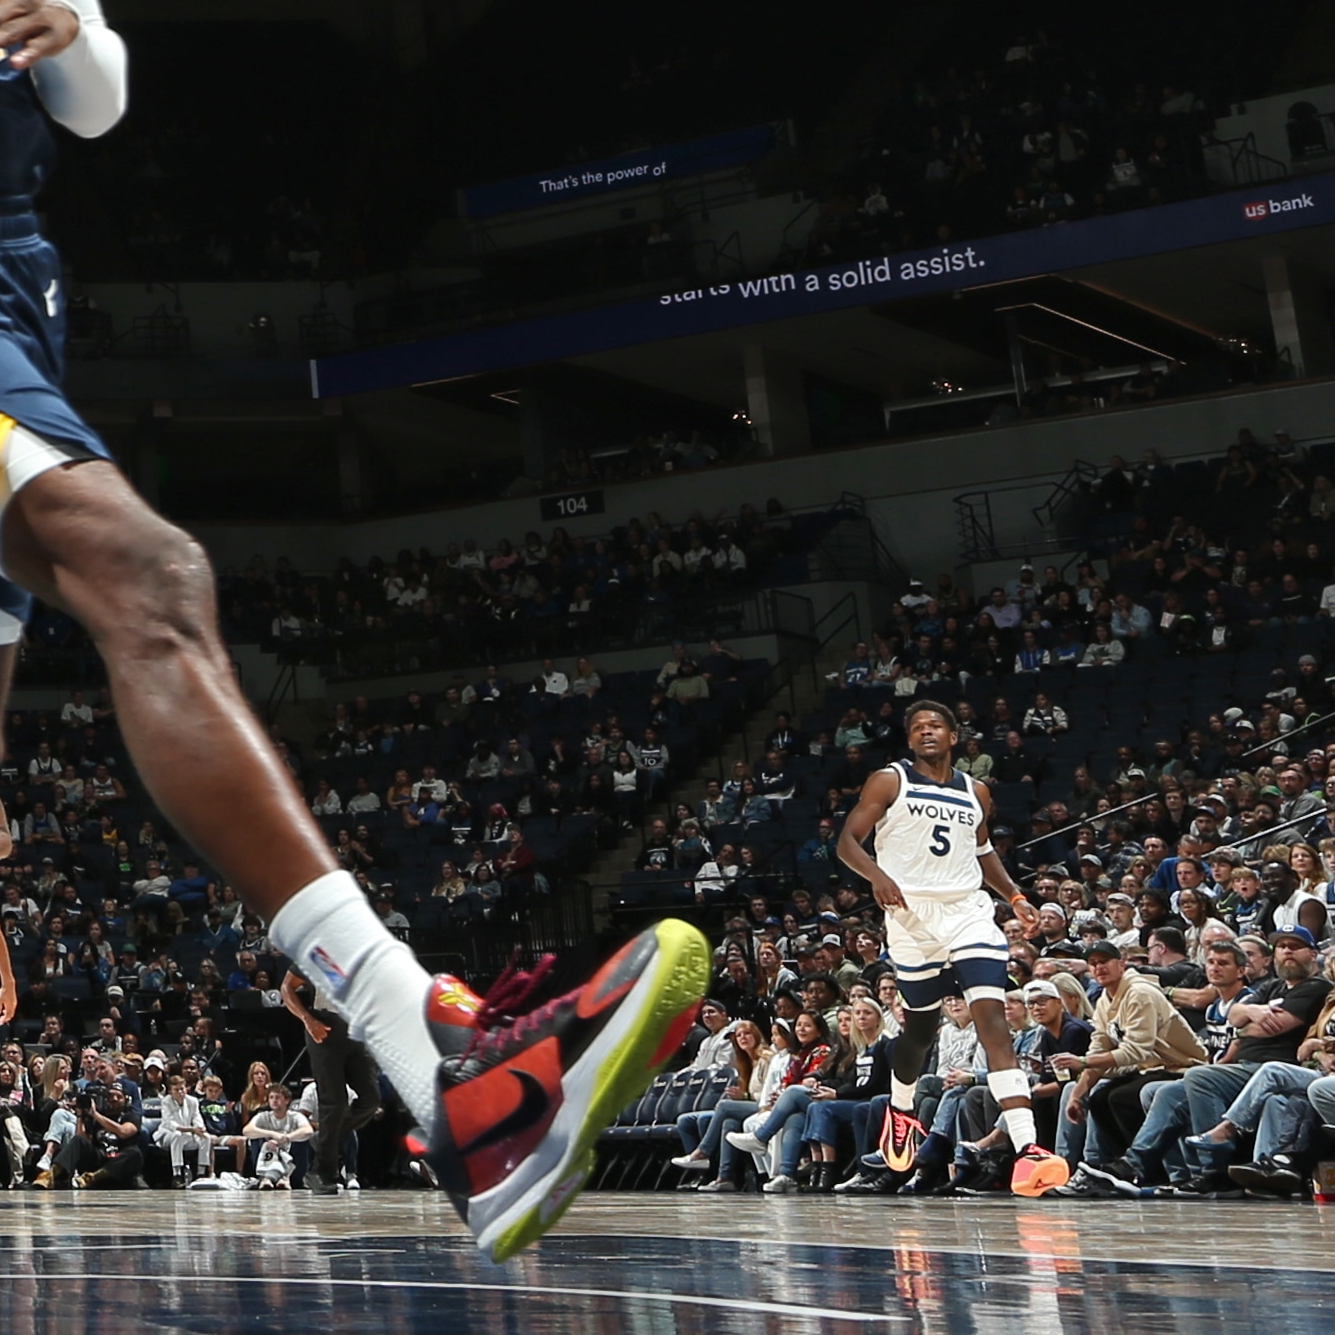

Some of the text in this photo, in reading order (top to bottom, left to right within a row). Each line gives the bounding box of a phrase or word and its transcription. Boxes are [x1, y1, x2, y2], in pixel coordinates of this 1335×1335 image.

[539, 161, 667, 193] That's the power of
[1245, 194, 1314, 217] us bank
[805, 274, 819, 292] a
[828, 258, 890, 290] solid
[900, 247, 985, 280] assist.
[557, 496, 588, 514] 104
[907, 803, 975, 826] WOLVES
[929, 824, 951, 857] 5
